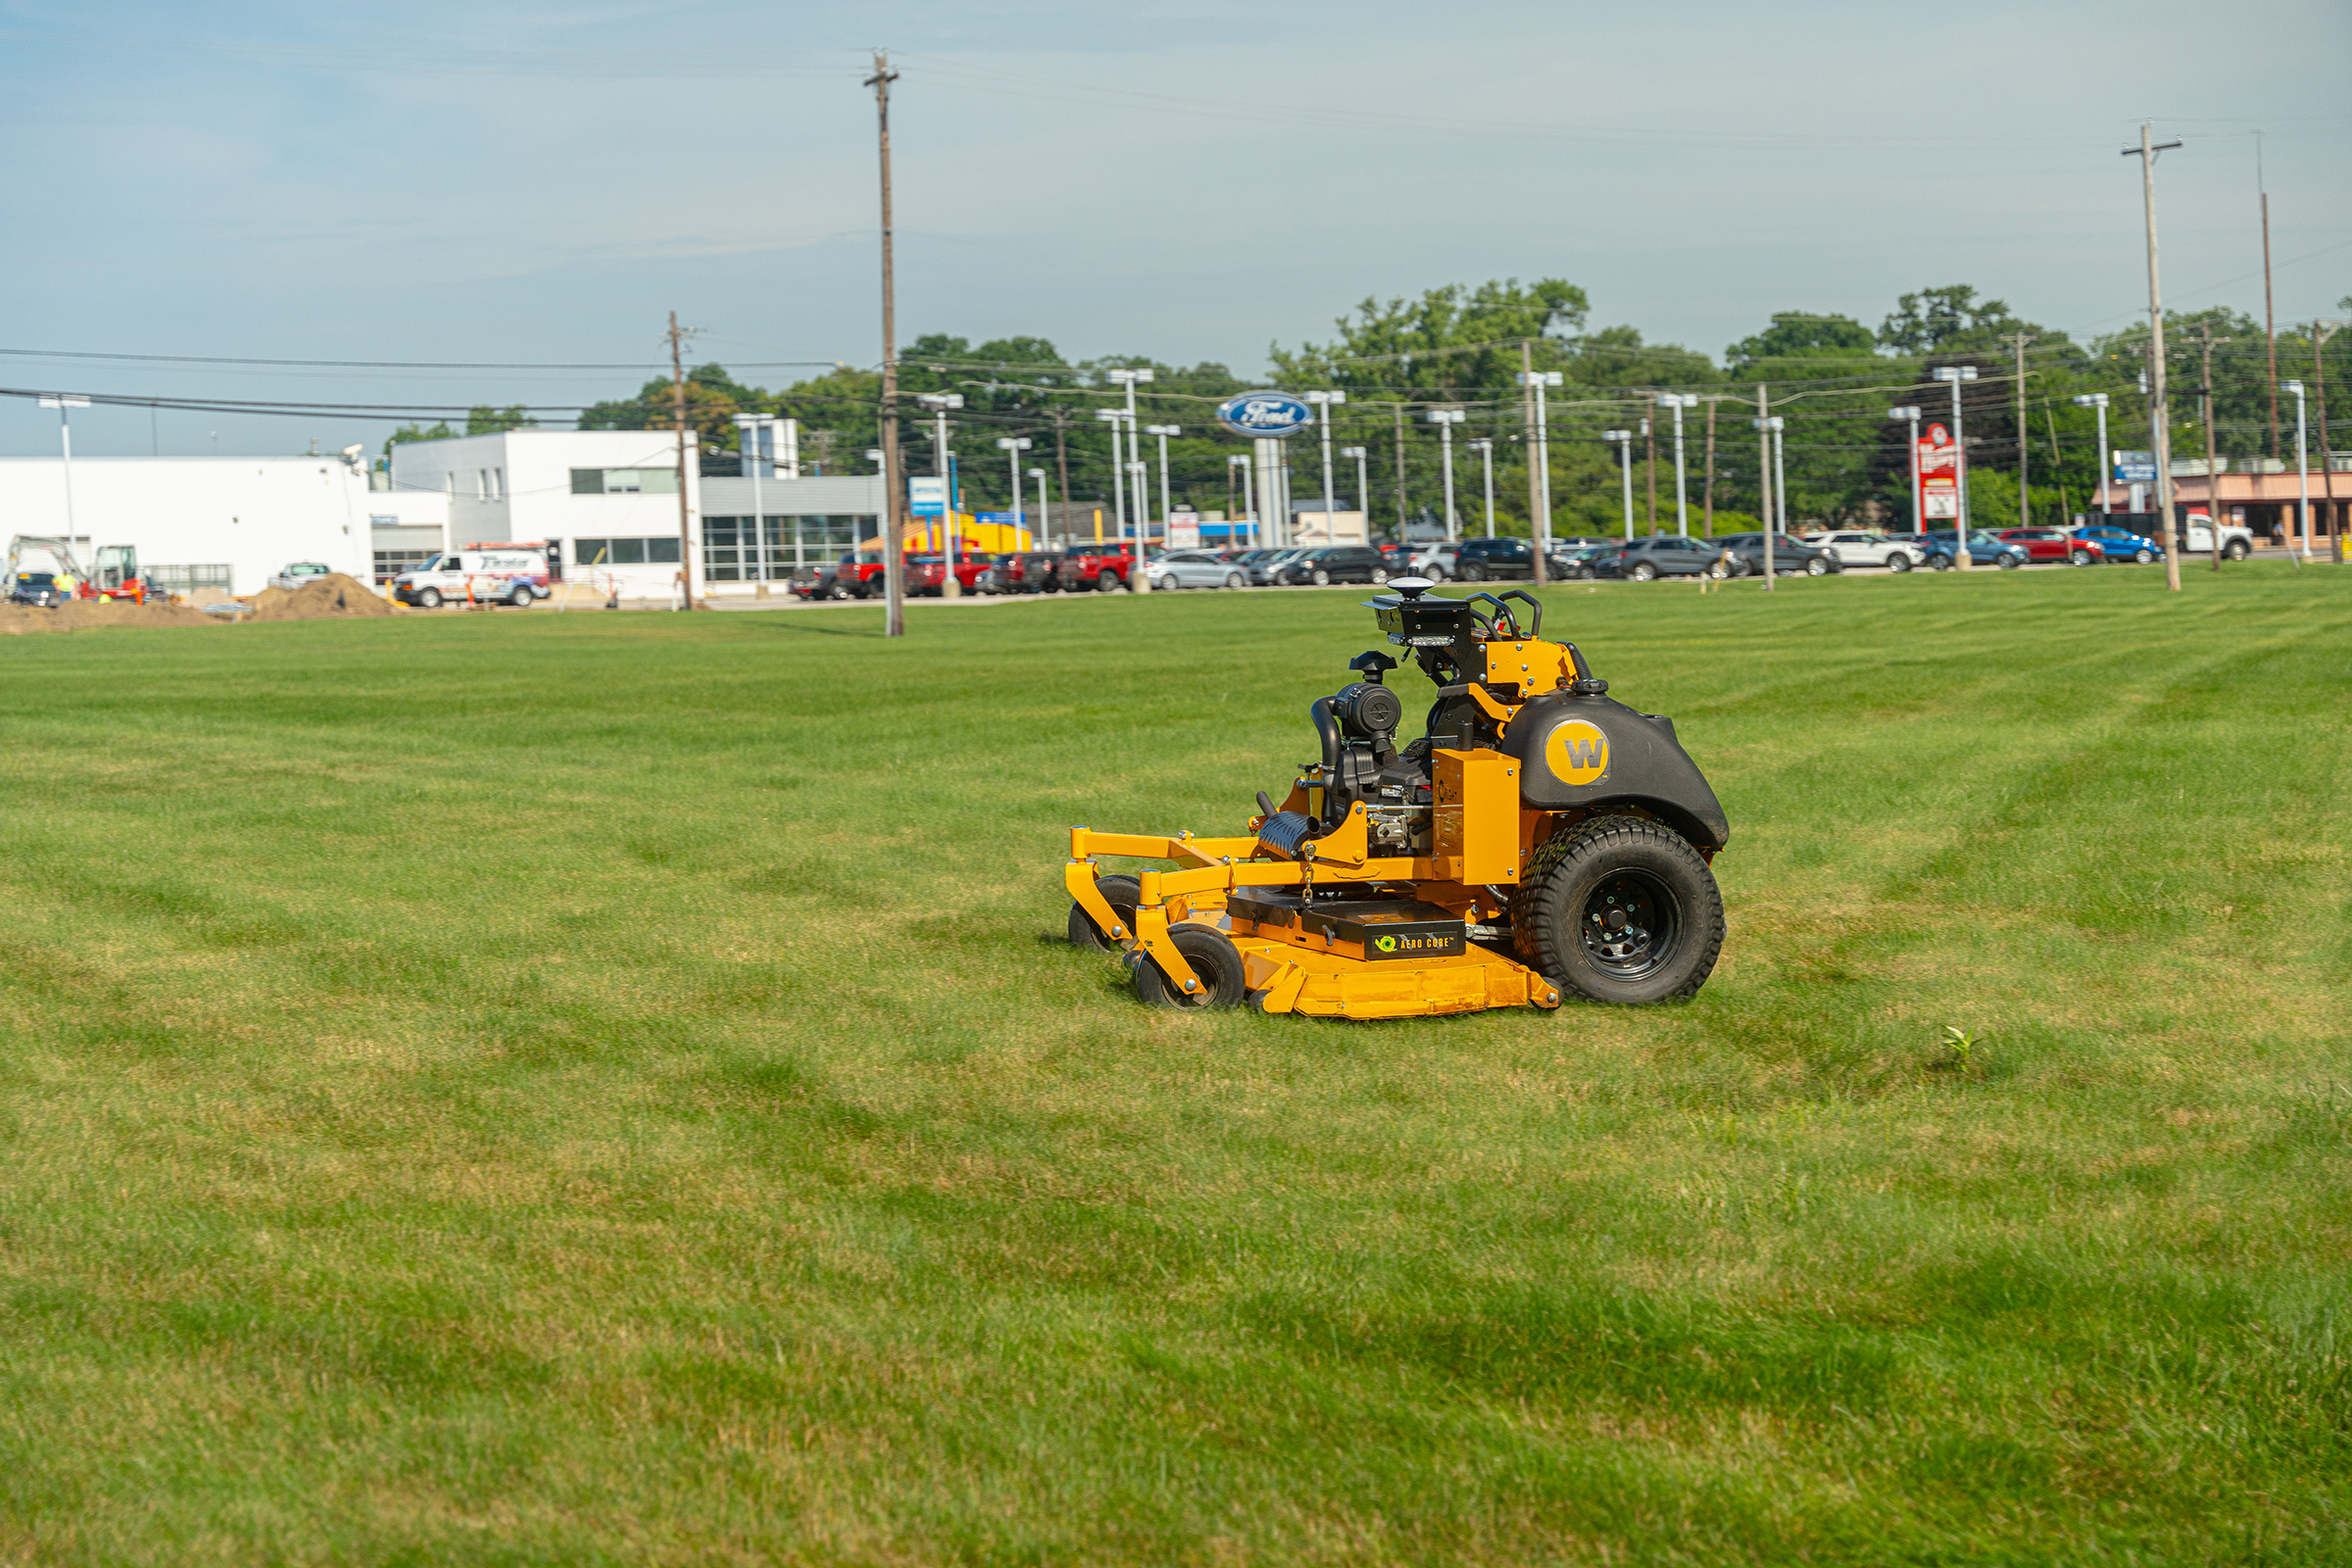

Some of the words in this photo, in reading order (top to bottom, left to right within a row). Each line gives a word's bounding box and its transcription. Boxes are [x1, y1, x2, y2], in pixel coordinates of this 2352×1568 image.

[1241, 401, 1296, 427] Ford
[1564, 738, 1604, 769] W
[1400, 939, 1423, 950] AERO
